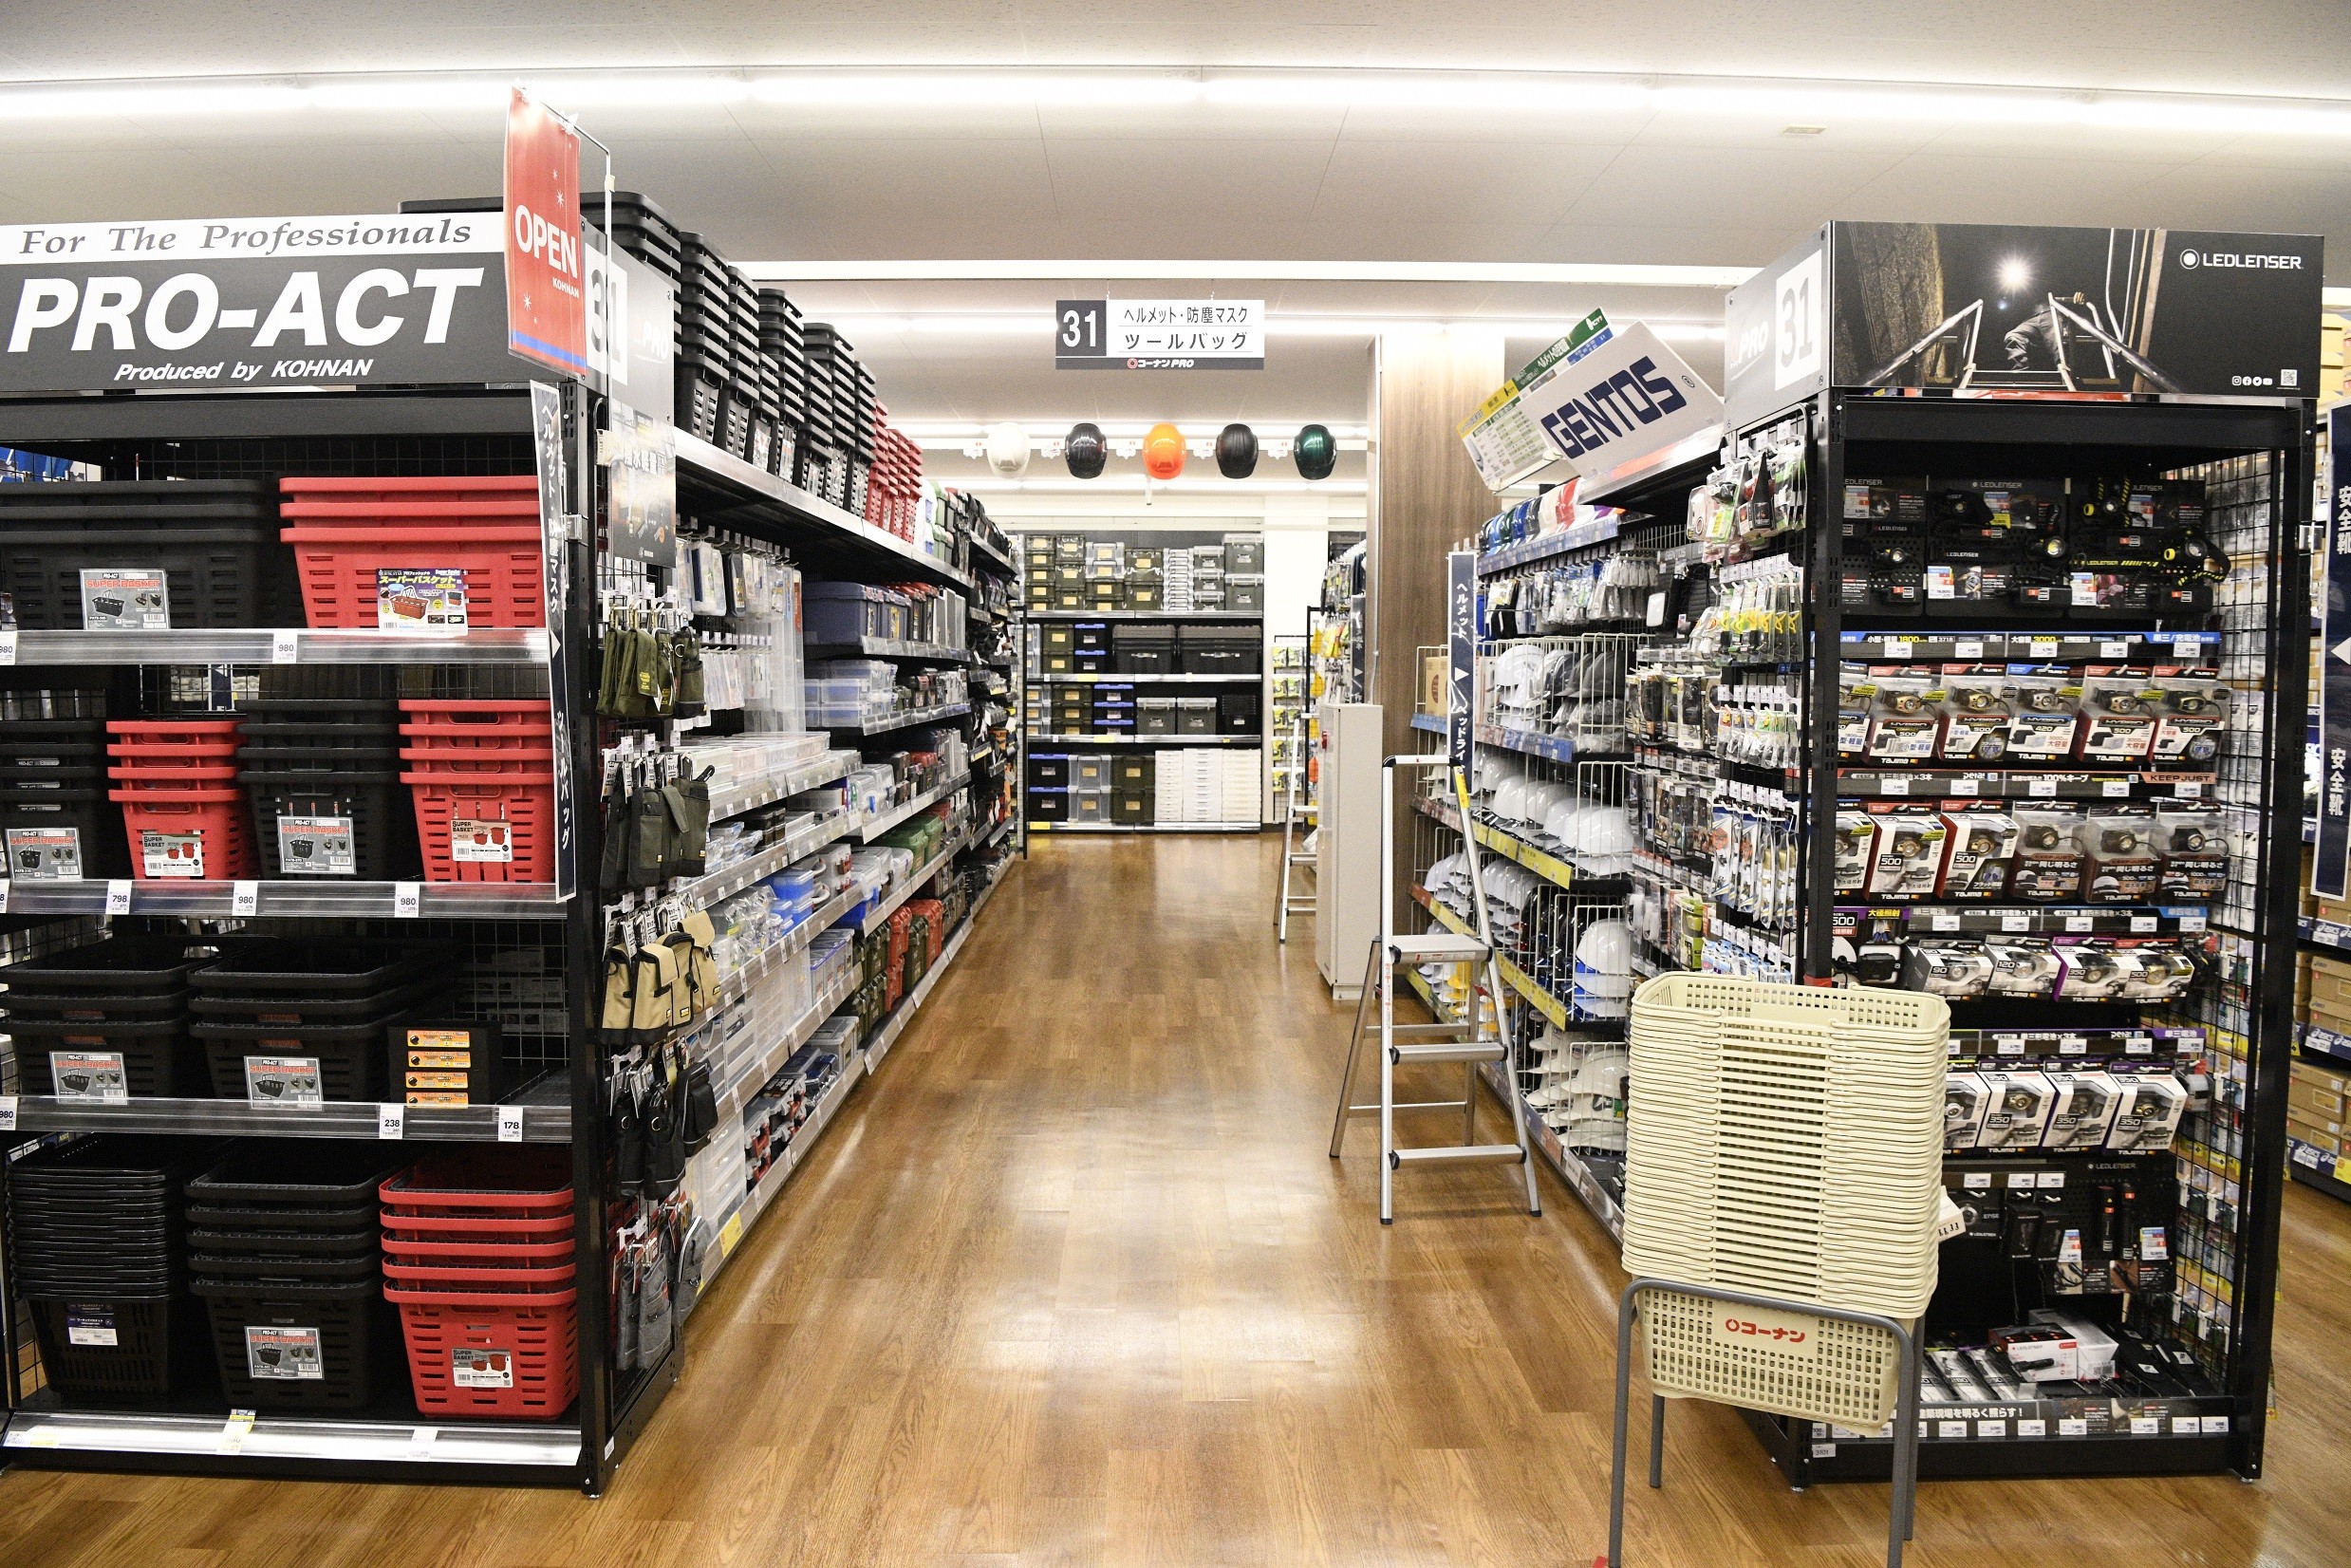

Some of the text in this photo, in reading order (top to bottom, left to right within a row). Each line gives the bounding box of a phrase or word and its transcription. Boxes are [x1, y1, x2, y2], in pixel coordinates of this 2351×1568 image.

[19, 217, 472, 256] For The Professionals
[515, 205, 578, 279] OPEN
[2203, 252, 2303, 270] LEDLENSER
[552, 277, 580, 299] KOHNAN
[7, 268, 485, 353] PRO-ACT
[1124, 307, 1248, 324] ヘルメット・防塵マスク
[1781, 276, 1813, 368] 31
[1062, 309, 1096, 347] 31
[1125, 332, 1248, 350] ツールバッグ
[1738, 321, 1769, 364] PRO
[113, 359, 374, 382] Produced by KOHNAN
[1138, 359, 1195, 368] コーナン PRO
[1539, 355, 1688, 459] GENTOS
[85, 580, 161, 588] SUPER BASKET
[379, 575, 457, 585] スーパーバスケット
[1456, 583, 1470, 639] ヘルメット
[1455, 706, 1470, 762] ヘッドライ
[556, 711, 570, 850] ツールバッグ
[2328, 747, 2346, 816] 安全靴
[10, 836, 76, 845] SUPER BASKET
[281, 826, 349, 835] SUPER BASKET
[2119, 1118, 2141, 1127] 350
[1742, 1321, 1805, 1343] コーナン
